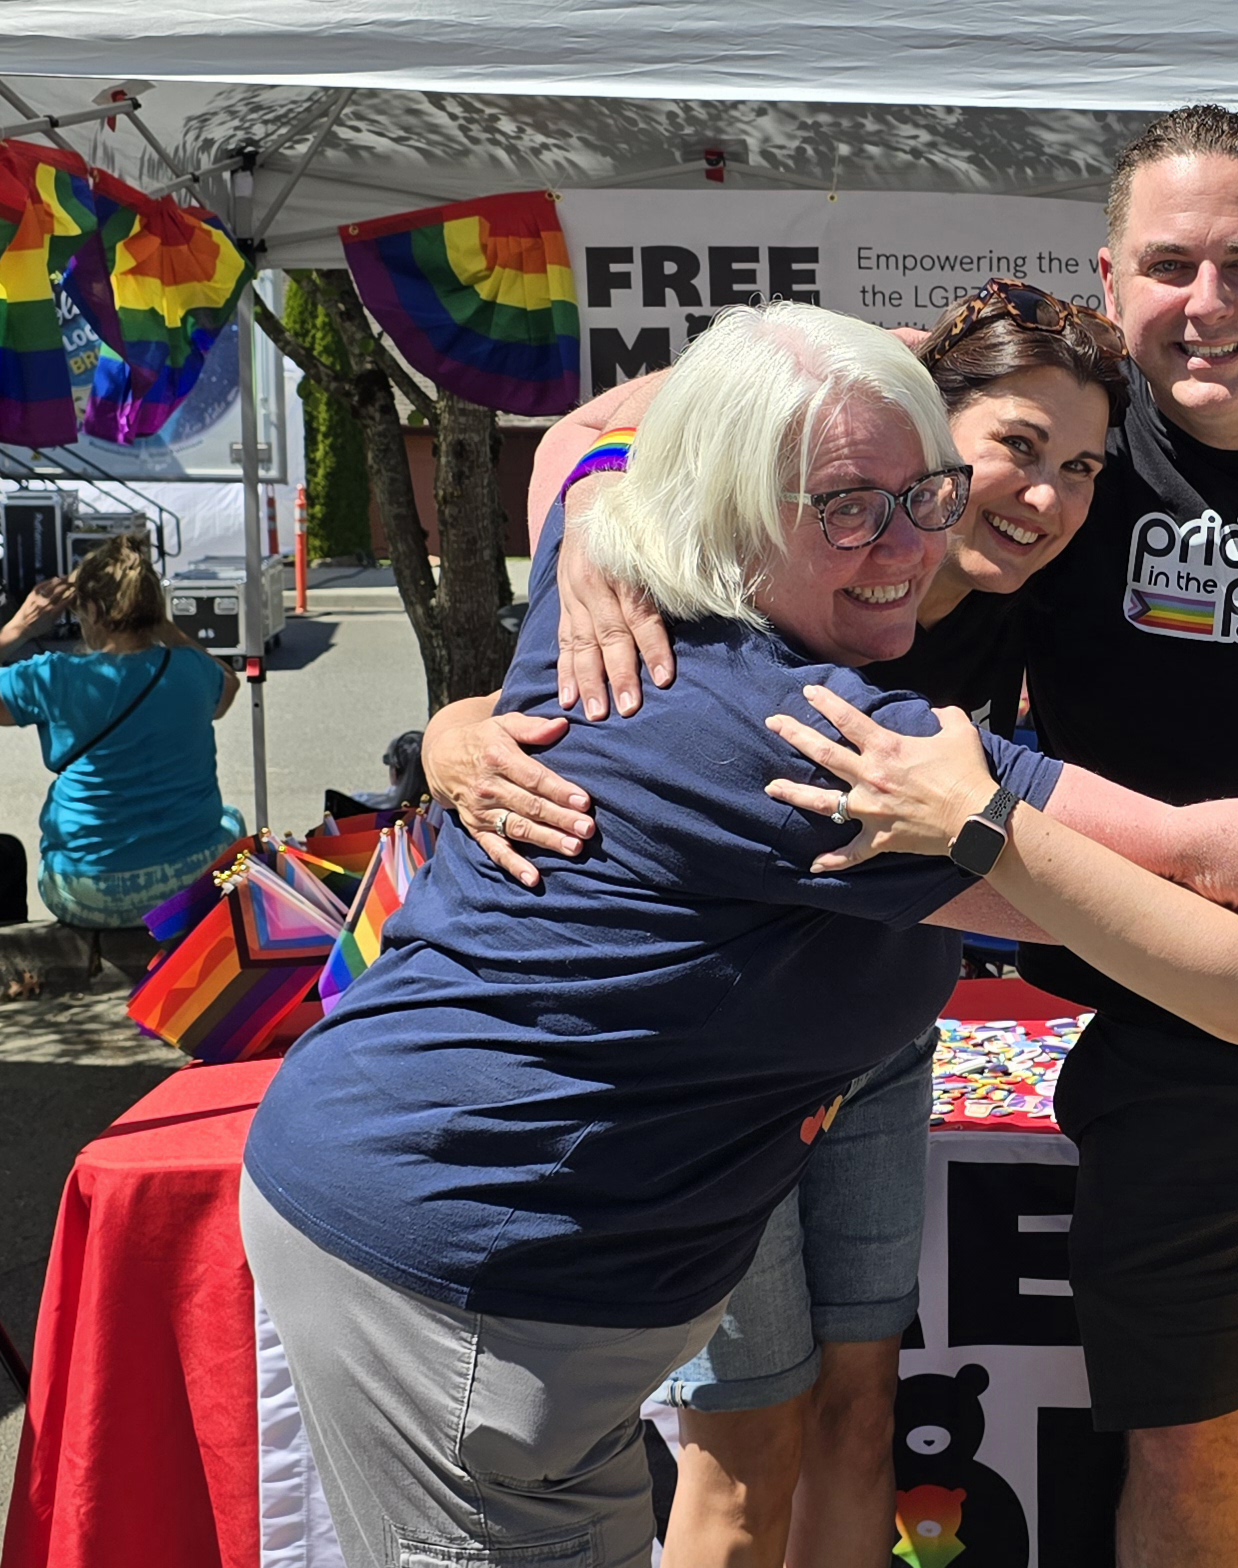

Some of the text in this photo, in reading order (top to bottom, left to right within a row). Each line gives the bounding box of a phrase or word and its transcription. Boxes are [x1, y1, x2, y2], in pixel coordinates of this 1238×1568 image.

[585, 245, 820, 308] FREE
[857, 246, 1028, 279] Empowering
[1036, 251, 1079, 274] the
[860, 284, 904, 308] the
[1148, 565, 1218, 595] in the
